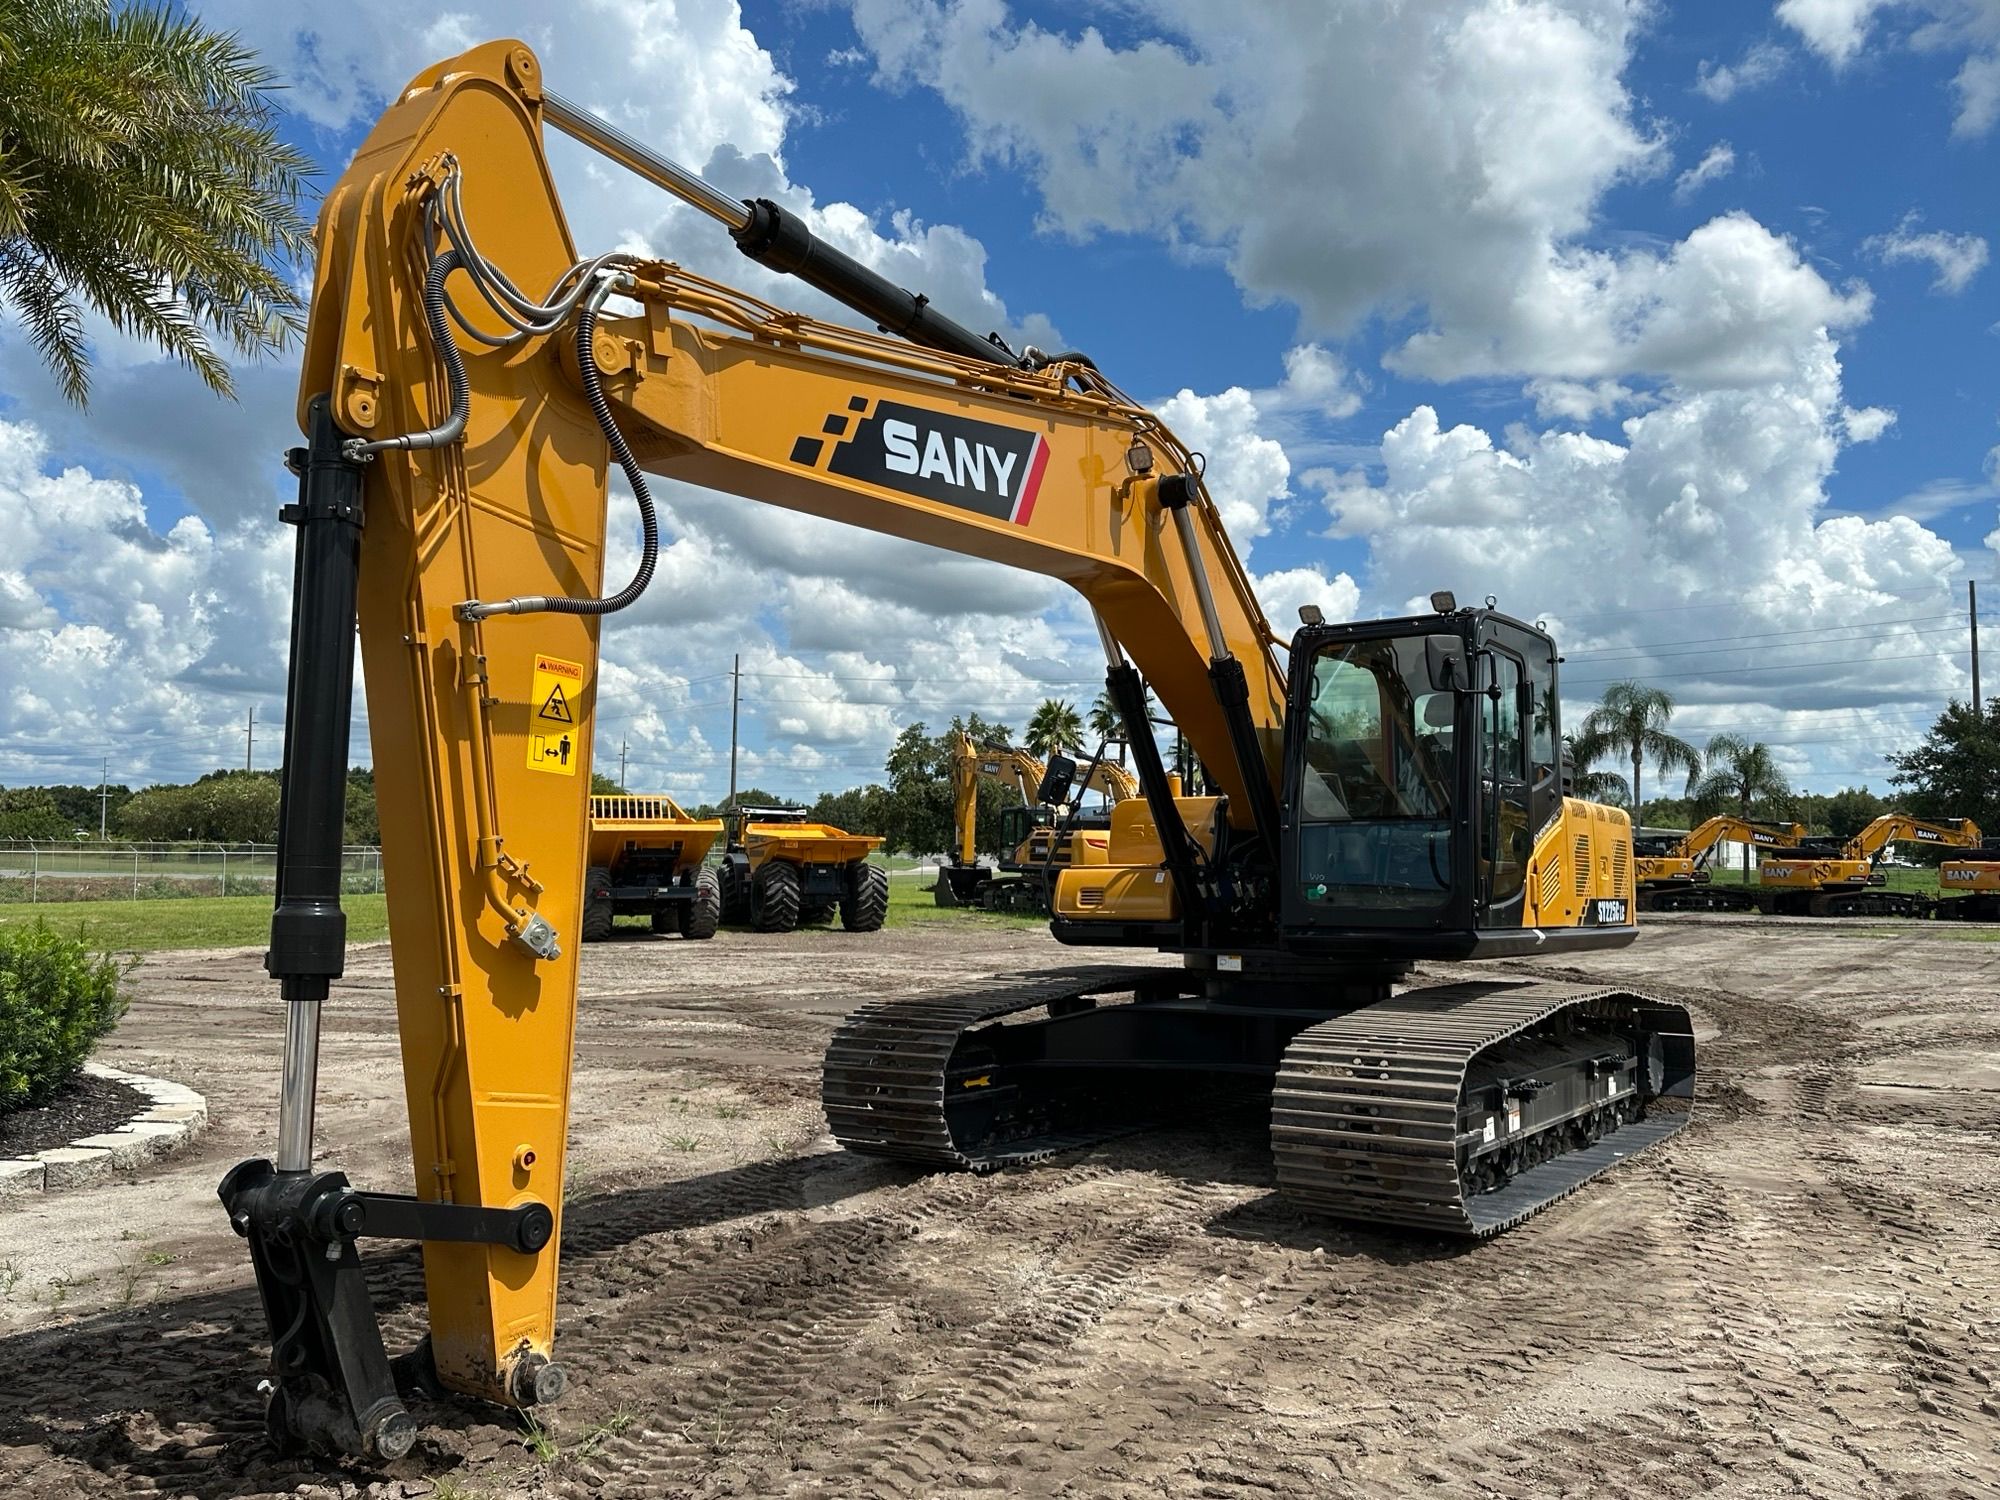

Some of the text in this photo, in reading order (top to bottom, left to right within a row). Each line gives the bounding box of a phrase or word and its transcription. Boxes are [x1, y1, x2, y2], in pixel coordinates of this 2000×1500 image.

[882, 418, 1018, 497] SANY
[548, 662, 578, 677] WARNING
[1754, 833, 1775, 843] SANY
[1917, 830, 1938, 840] SANY
[1764, 868, 1793, 878] SANY
[1946, 870, 1981, 881] SANY
